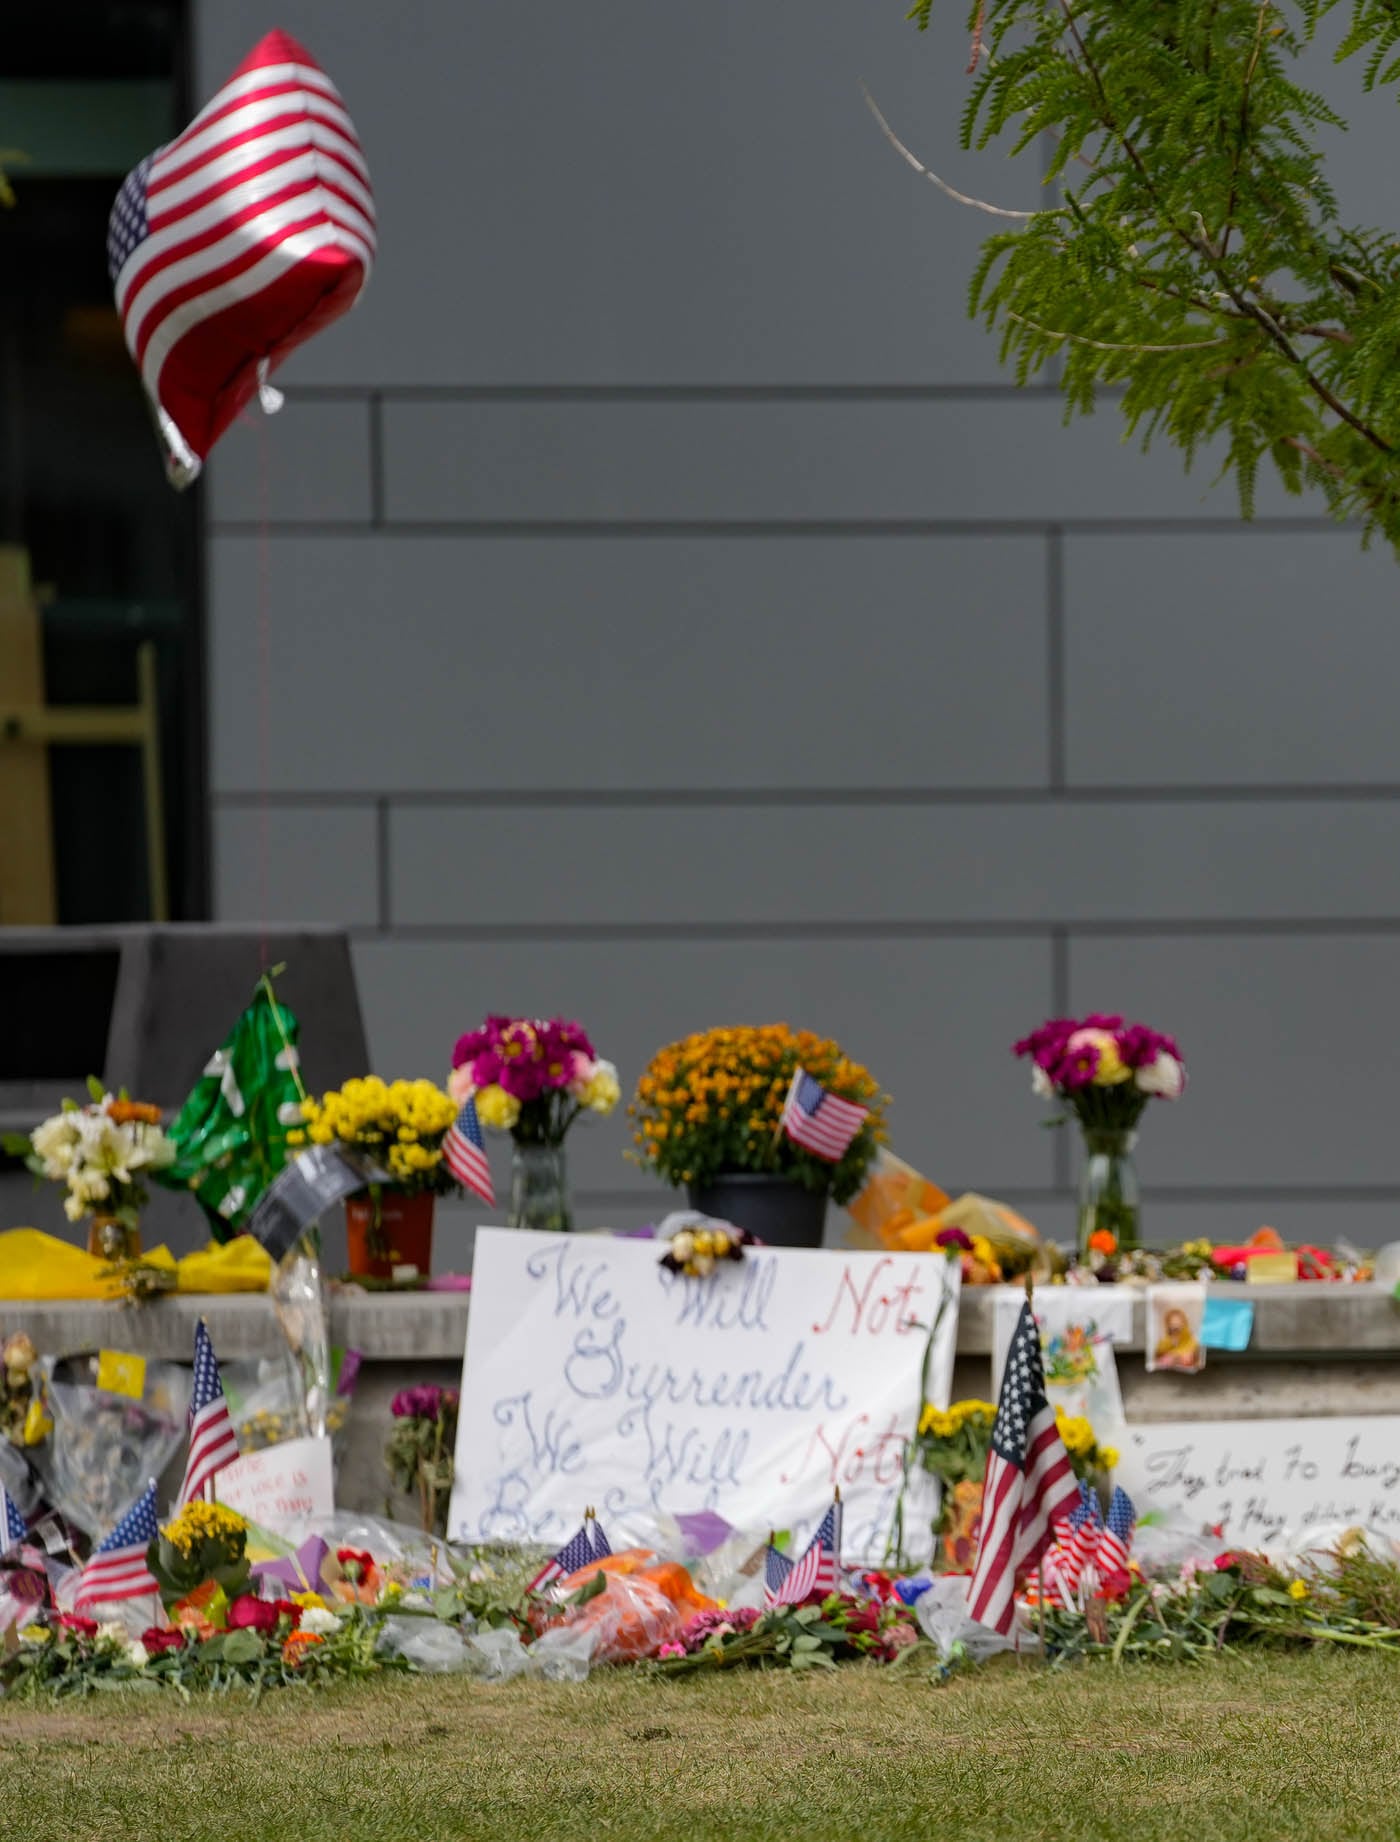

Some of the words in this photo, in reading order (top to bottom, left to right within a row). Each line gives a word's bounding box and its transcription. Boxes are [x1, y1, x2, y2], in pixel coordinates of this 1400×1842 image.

[527, 1241, 620, 1320] We
[659, 1256, 778, 1331] Will
[812, 1257, 924, 1336] Not
[564, 1319, 847, 1410] Surrender
[493, 1390, 588, 1475] We
[617, 1402, 751, 1486] Will
[780, 1413, 907, 1486] Not
